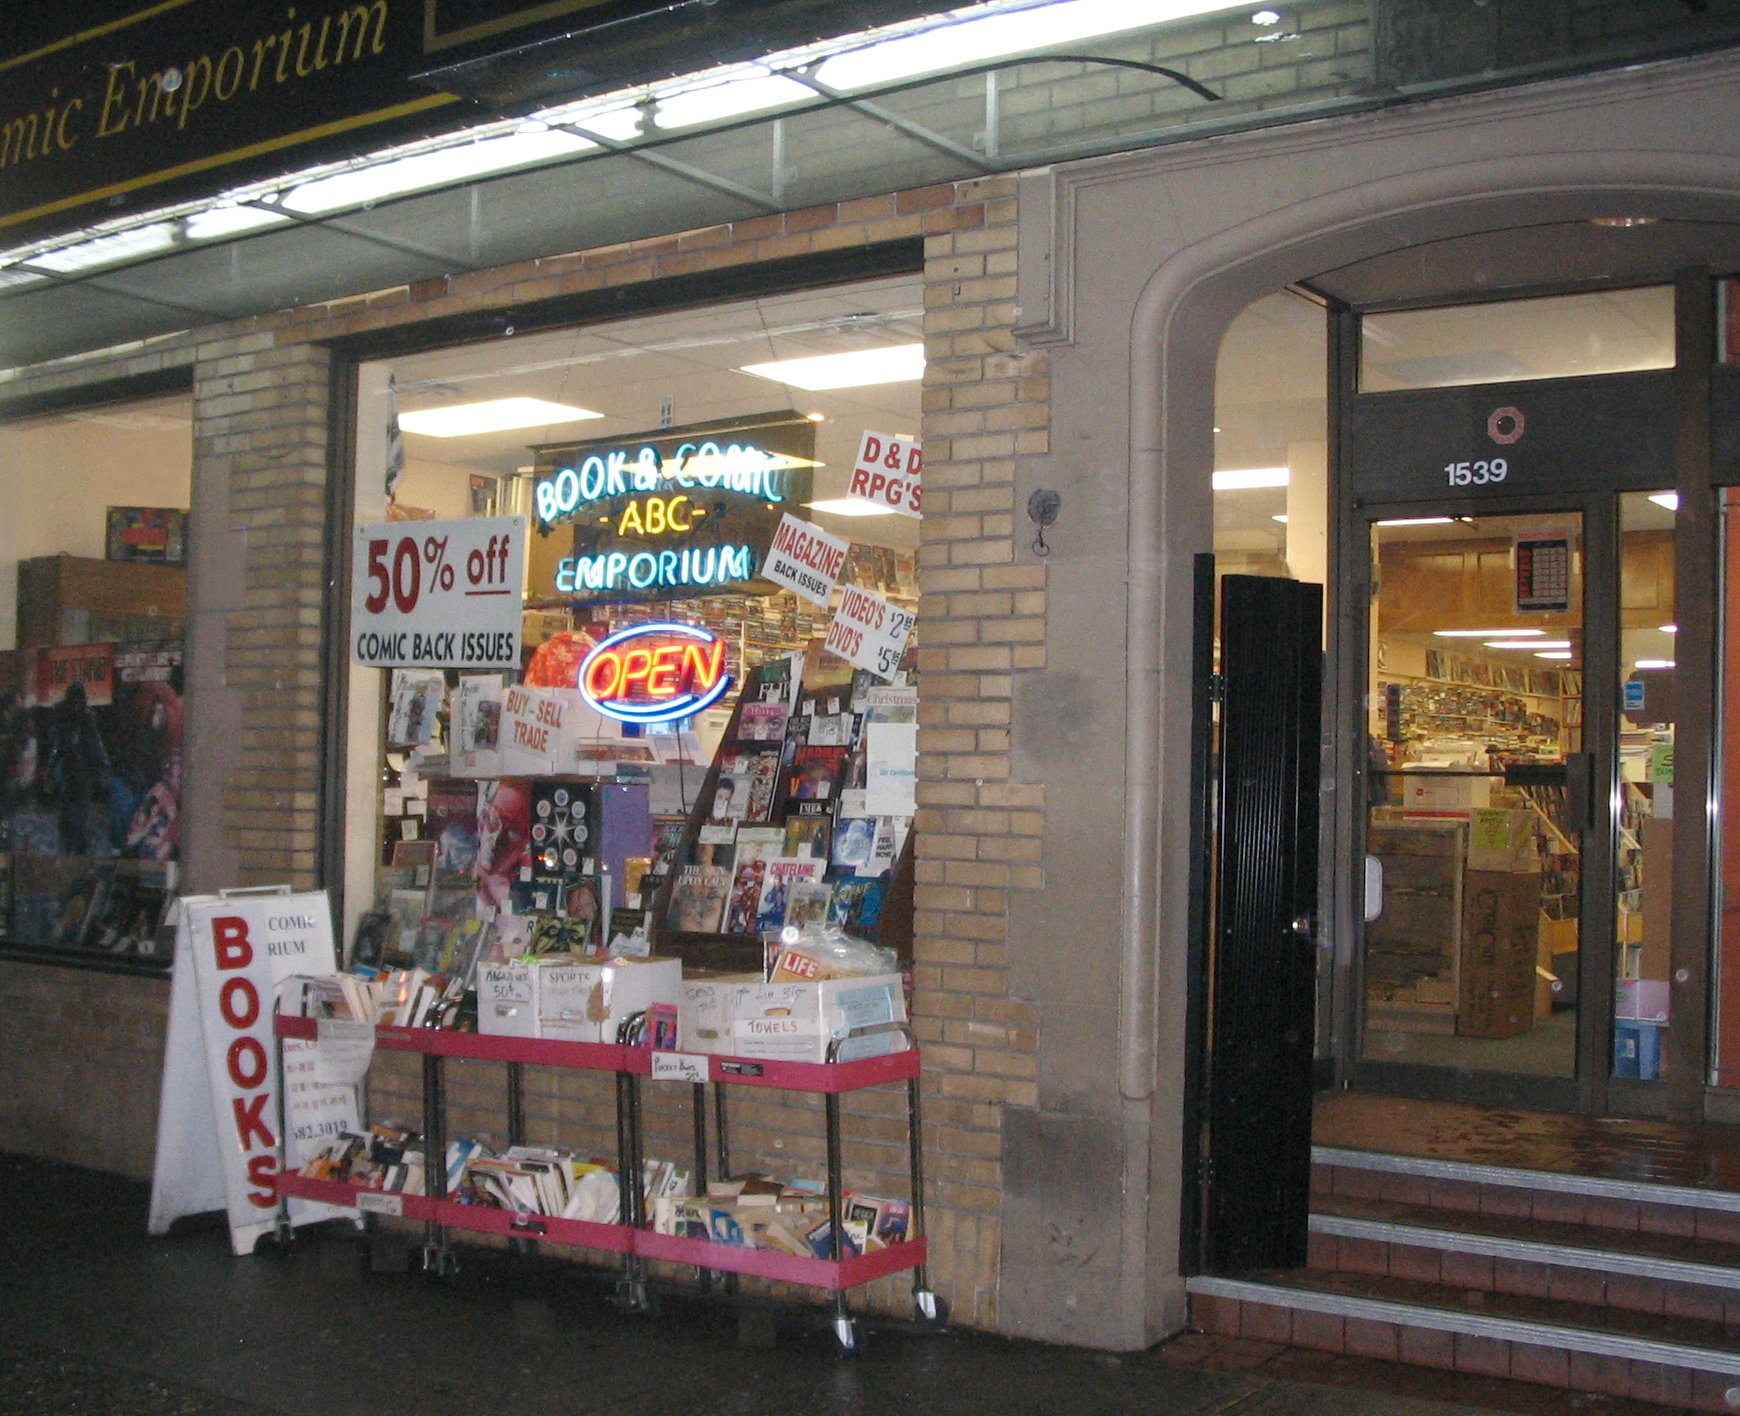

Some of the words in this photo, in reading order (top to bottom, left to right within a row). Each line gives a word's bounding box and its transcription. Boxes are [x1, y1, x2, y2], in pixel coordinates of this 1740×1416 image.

[97, 0, 388, 137] Emporium
[536, 451, 626, 522] BOOK
[850, 468, 923, 512] RPG'S
[1444, 458, 1508, 486] 1539
[617, 495, 691, 536] ABC
[555, 544, 750, 593] EMPORIUM
[773, 520, 845, 580] MAGAZINE
[364, 535, 455, 614] 50%
[466, 534, 510, 586] off
[774, 559, 799, 583] BACK
[798, 570, 828, 597] ISSUES
[840, 590, 886, 630] VIDEO'S
[356, 632, 408, 661] COMIC
[412, 632, 457, 661] BACK
[460, 632, 514, 662] ISSUES
[827, 621, 864, 657] DVD'S
[585, 638, 723, 700] OPEN
[506, 689, 529, 716] BUY
[536, 701, 562, 728] SELL
[514, 722, 549, 752] TRADE
[268, 915, 316, 931] COMIC
[268, 940, 306, 957] RIUM
[783, 953, 818, 978] LIFE
[748, 1019, 797, 1034] TOWELS
[211, 916, 281, 1209] BOOKS
